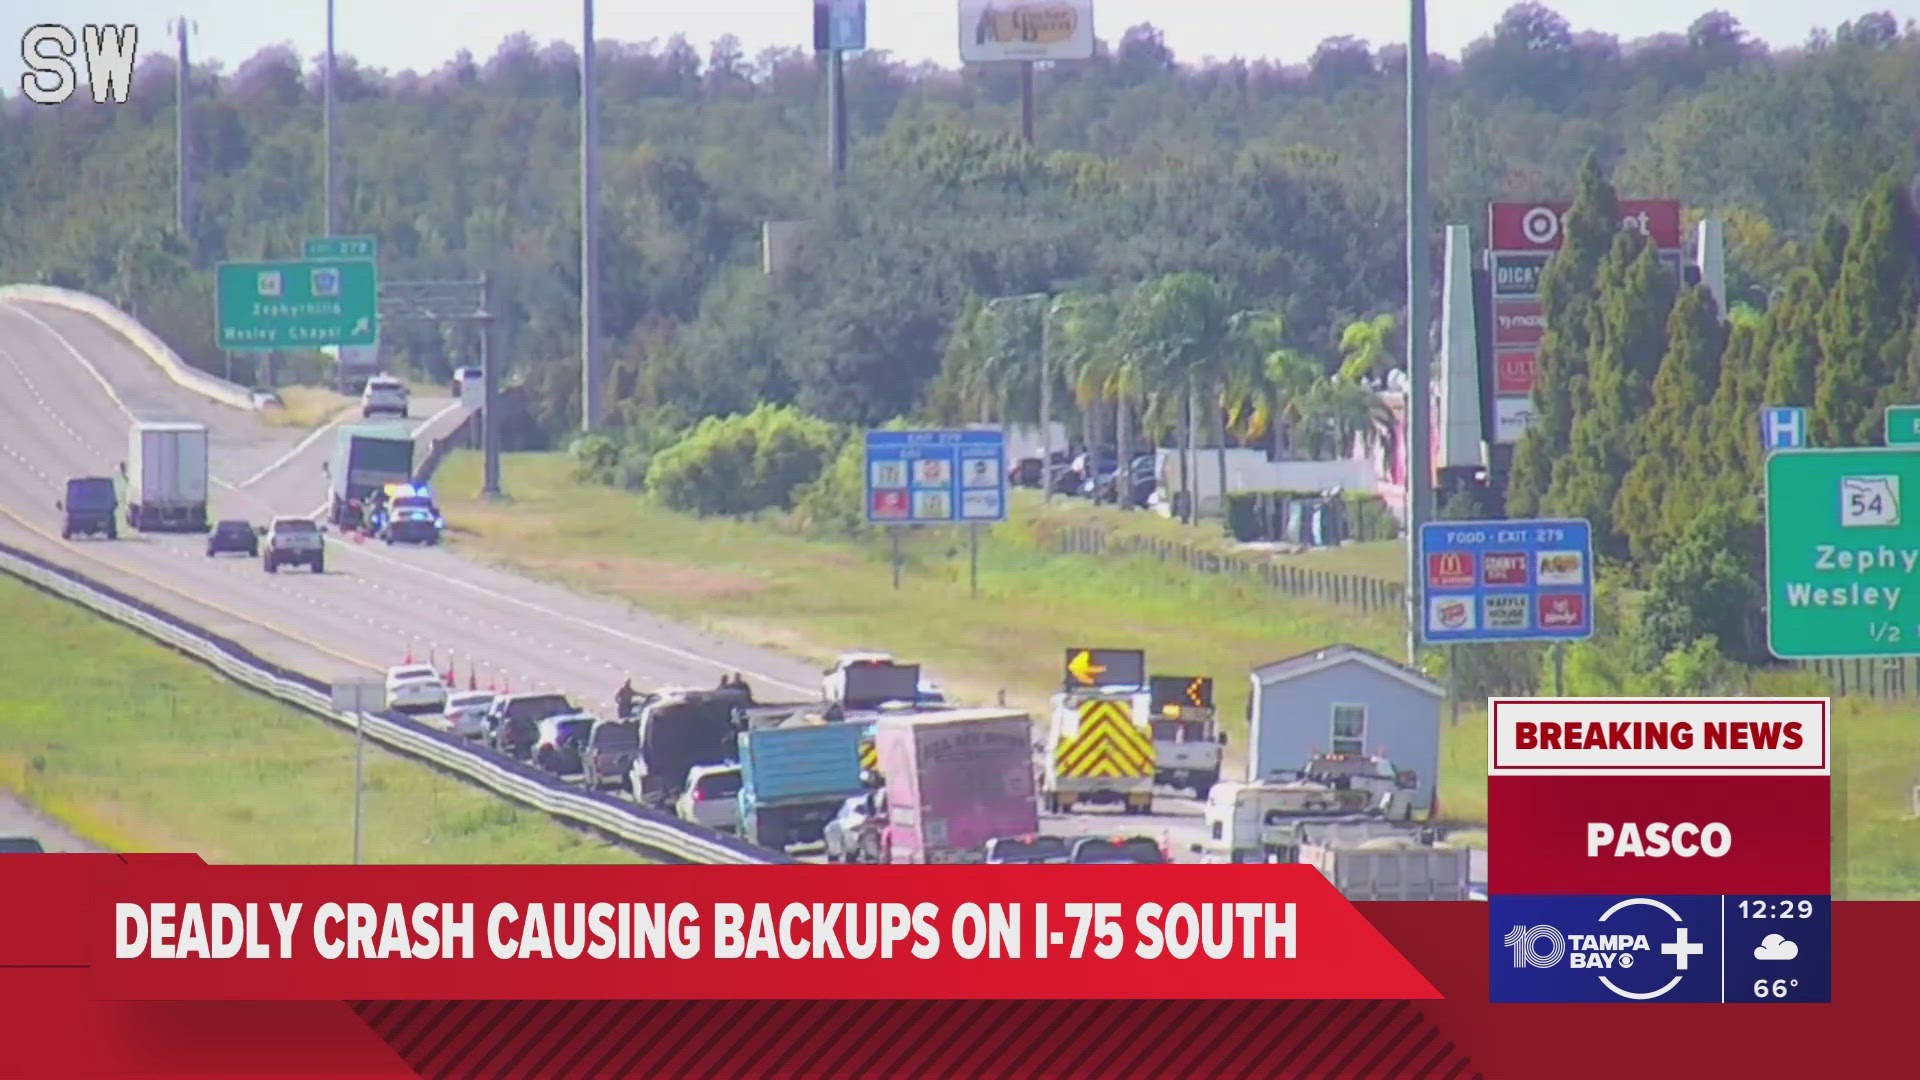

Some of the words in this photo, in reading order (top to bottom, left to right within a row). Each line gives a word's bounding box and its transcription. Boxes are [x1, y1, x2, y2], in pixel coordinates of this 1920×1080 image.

[224, 327, 276, 341] Wesley
[288, 327, 341, 341] Chapel
[1507, 360, 1534, 375] ULT
[1770, 410, 1799, 446] H
[1851, 494, 1882, 516] 54
[1446, 531, 1486, 544] FOOD
[1498, 530, 1527, 543] EXIT
[1536, 528, 1564, 542] 279
[1786, 582, 1901, 611] Wesley
